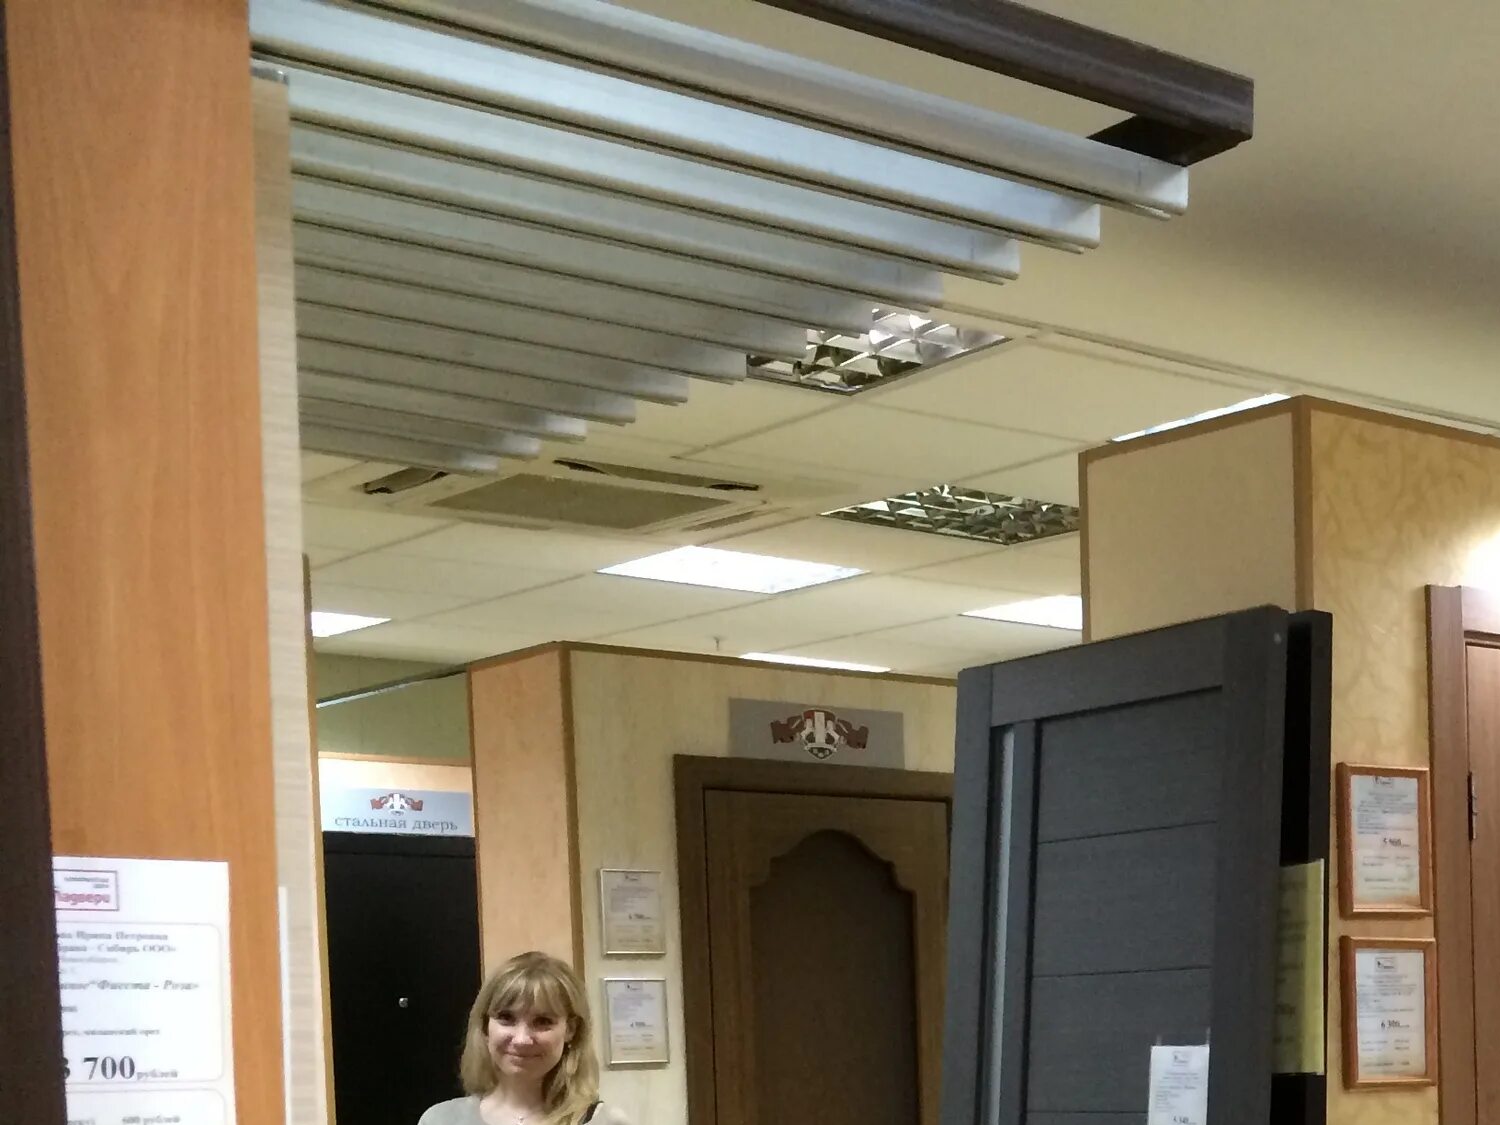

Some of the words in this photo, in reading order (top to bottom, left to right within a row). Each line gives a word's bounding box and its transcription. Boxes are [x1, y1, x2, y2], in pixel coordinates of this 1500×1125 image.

[334, 816, 407, 830] стальная
[411, 819, 459, 834] дверь
[82, 1055, 136, 1081] 700
